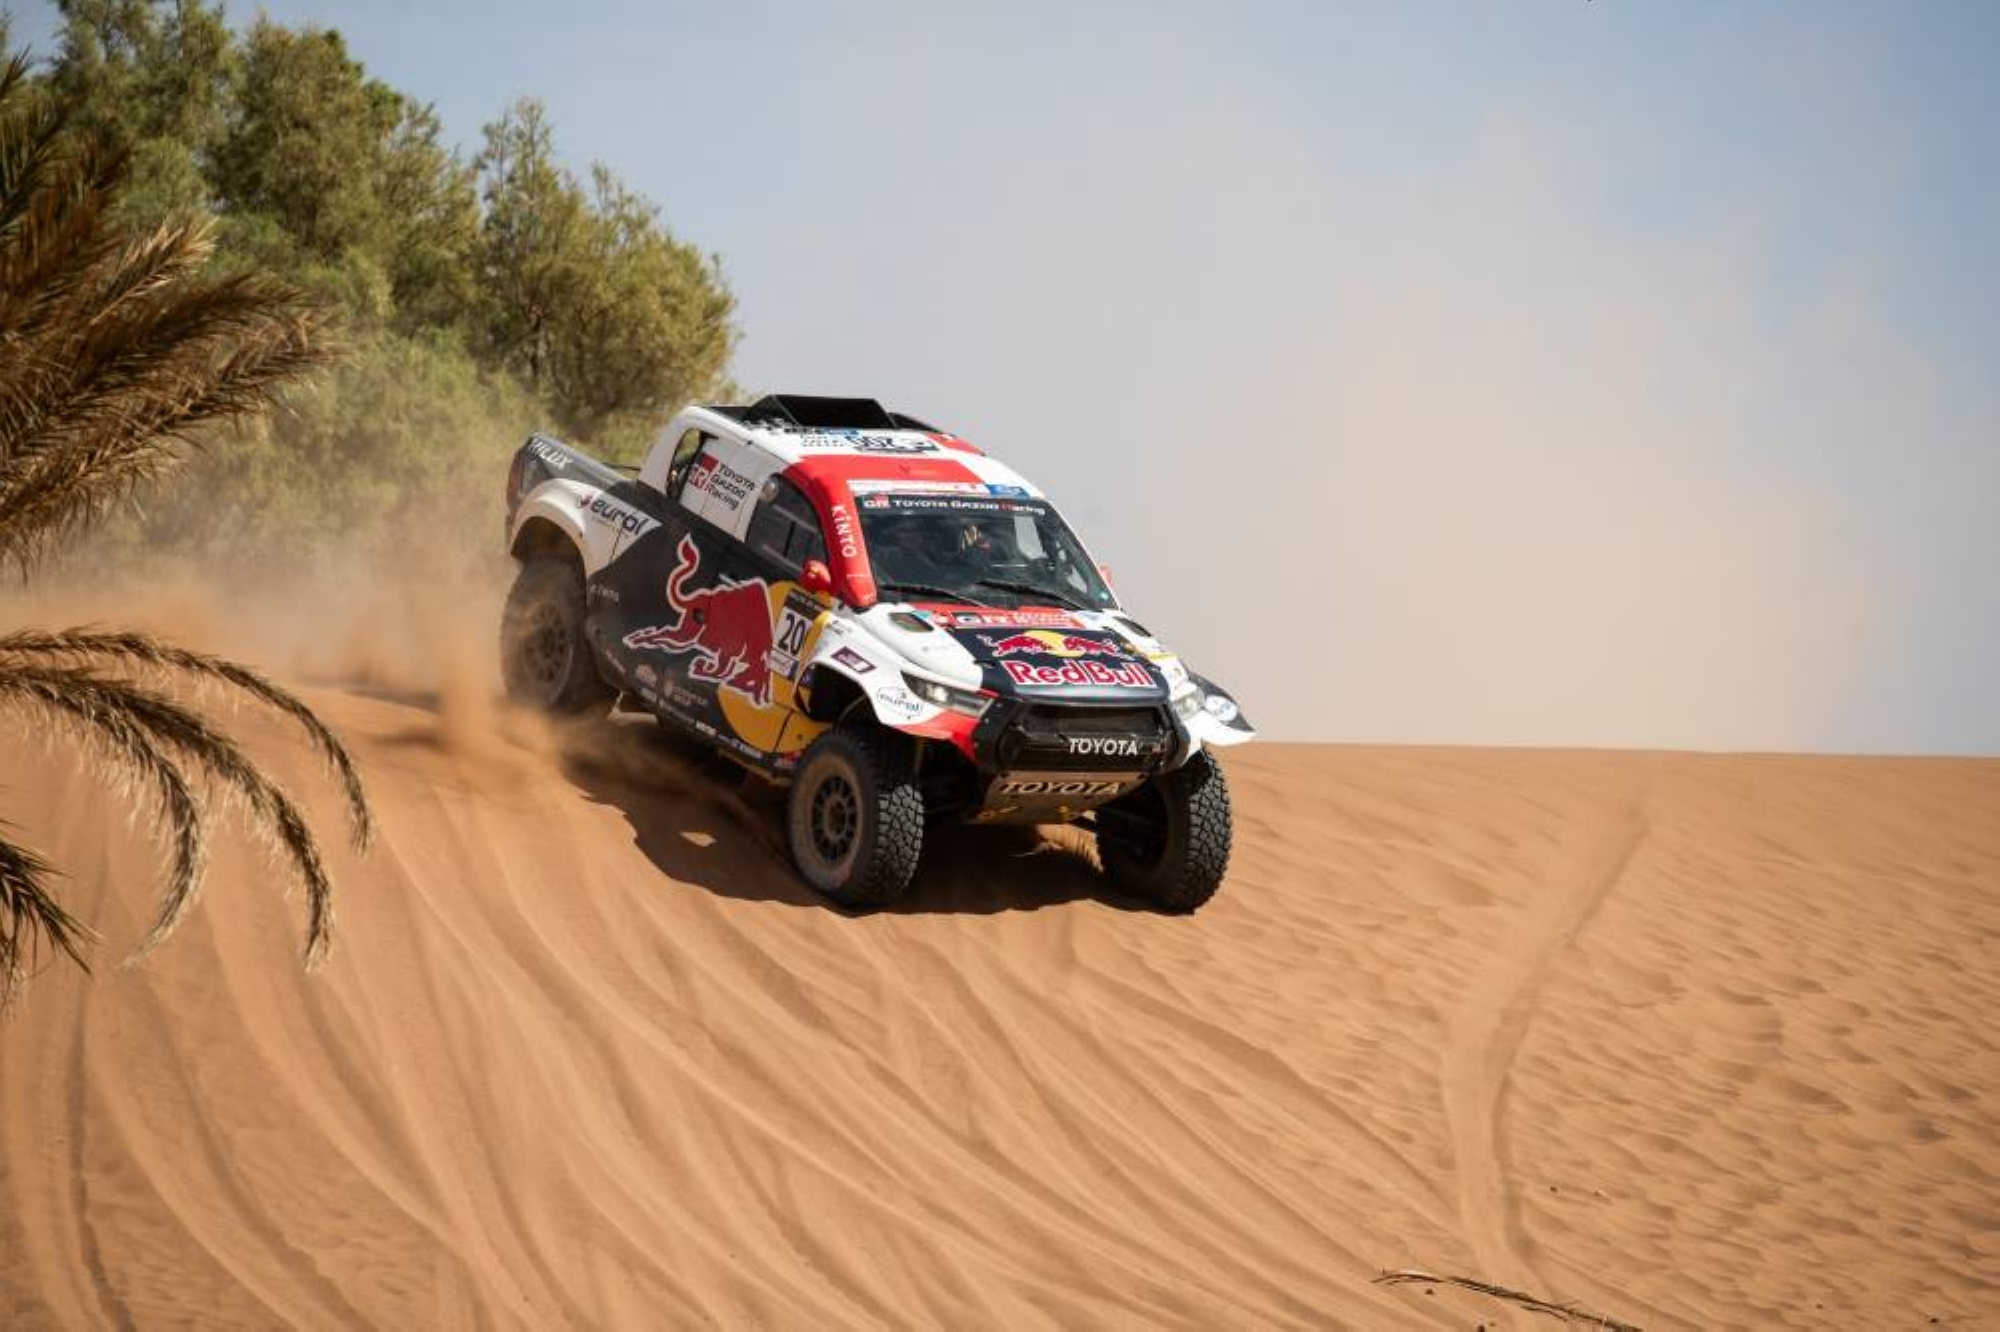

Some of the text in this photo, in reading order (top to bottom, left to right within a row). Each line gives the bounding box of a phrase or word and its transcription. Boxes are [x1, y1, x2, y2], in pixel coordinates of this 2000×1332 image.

[711, 474, 747, 499] GAZOO
[719, 463, 755, 491] TOYOTA
[590, 500, 649, 535] eurol
[895, 500, 948, 508] TOYOTA
[950, 501, 999, 510] GAZOO
[1002, 502, 1045, 515] Racing
[778, 612, 806, 656] 20
[1001, 660, 1156, 688] Red Bull
[1069, 738, 1138, 756] TOYOTA
[1001, 781, 1121, 795] TOYOTA
